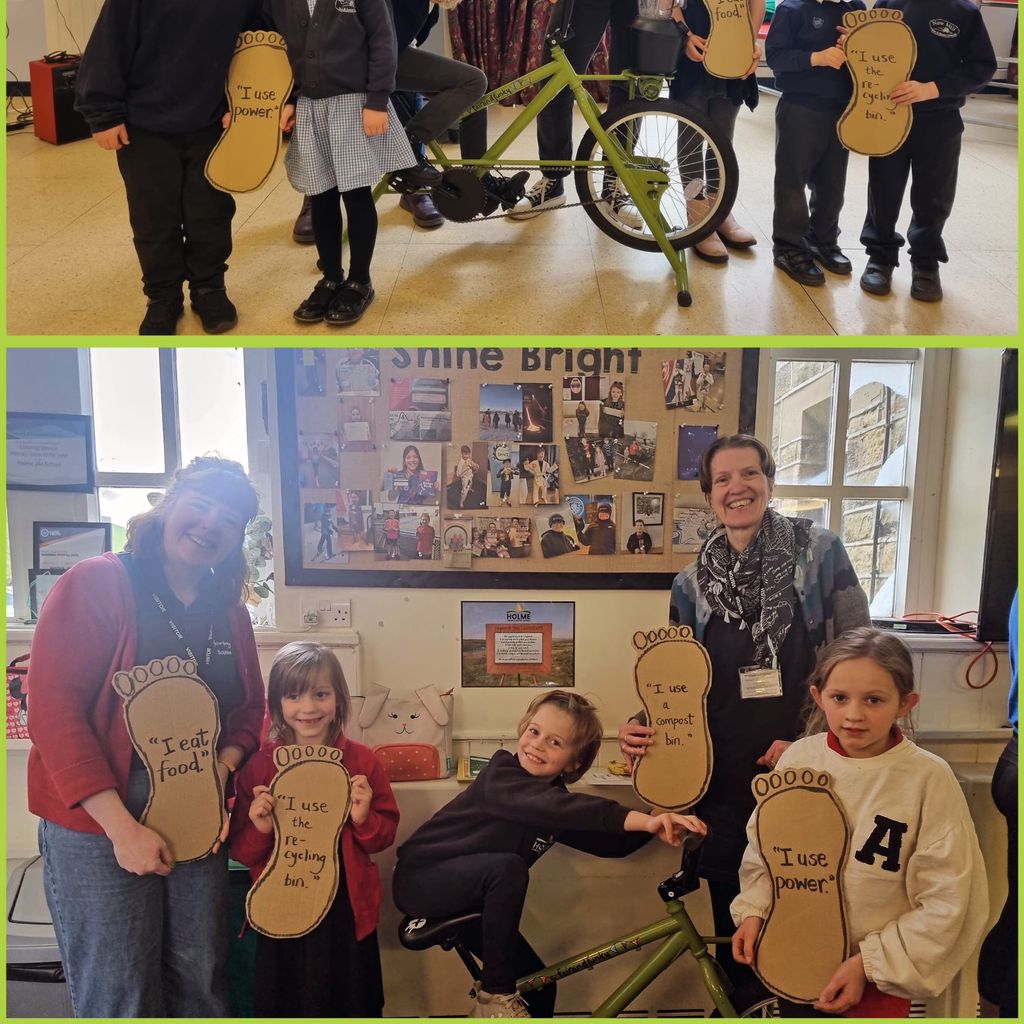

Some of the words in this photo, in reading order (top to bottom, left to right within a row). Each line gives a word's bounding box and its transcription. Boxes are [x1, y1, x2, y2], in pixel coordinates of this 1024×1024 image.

[714, 3, 745, 21] food."
[850, 49, 868, 62] "I
[872, 54, 896, 63] use
[866, 65, 884, 76] the
[237, 84, 252, 100] "I
[254, 90, 276, 101] use
[862, 80, 879, 88] re-
[862, 91, 898, 111] cyclin
[233, 104, 279, 123] power."
[866, 109, 896, 121] bin."
[646, 683, 664, 694] "I
[669, 684, 688, 693] use
[656, 713, 695, 730] compost
[149, 737, 176, 756] "I
[179, 728, 209, 751] eat
[665, 732, 693, 746] bin."
[156, 749, 209, 782] food."
[277, 794, 296, 810] "I
[302, 802, 329, 813] use
[292, 816, 312, 829] the
[285, 836, 307, 846] re-
[855, 814, 908, 872] A
[284, 848, 326, 874] cycling
[773, 846, 794, 867] "I
[798, 852, 829, 867] use
[284, 873, 320, 888] bin."
[775, 874, 835, 899] power."
